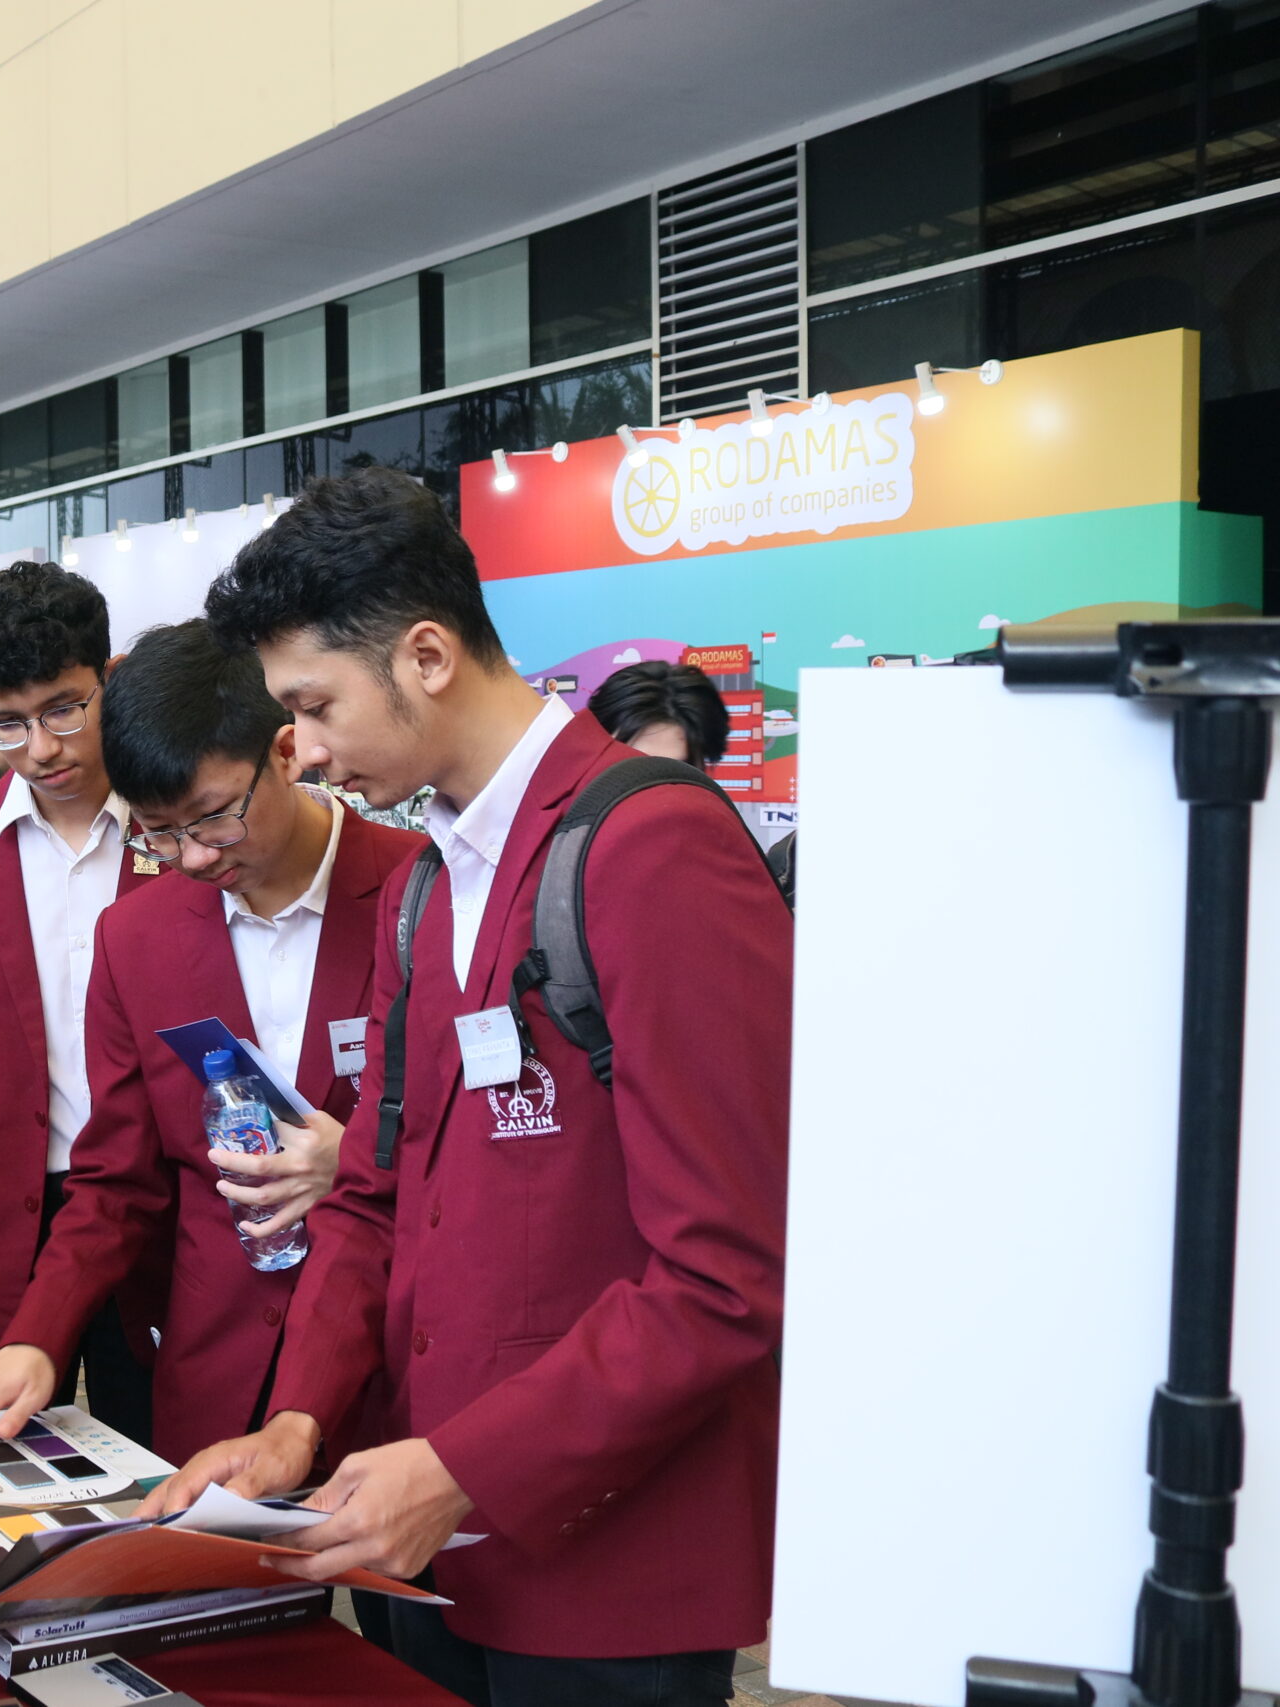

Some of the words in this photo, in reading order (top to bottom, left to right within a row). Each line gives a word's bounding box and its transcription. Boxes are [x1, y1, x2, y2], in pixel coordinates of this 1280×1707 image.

[689, 412, 900, 494] RODAMAS
[690, 500, 746, 533] group
[752, 492, 773, 519] of
[779, 477, 898, 516] companies
[701, 649, 744, 663] RODAMAS
[497, 1114, 554, 1131] CALVIN
[525, 1125, 562, 1136] TECHNOLOGY
[34, 1620, 86, 1638] SolarTuff
[160, 1634, 177, 1643] VINYL
[41, 1648, 88, 1668] ALVERA
